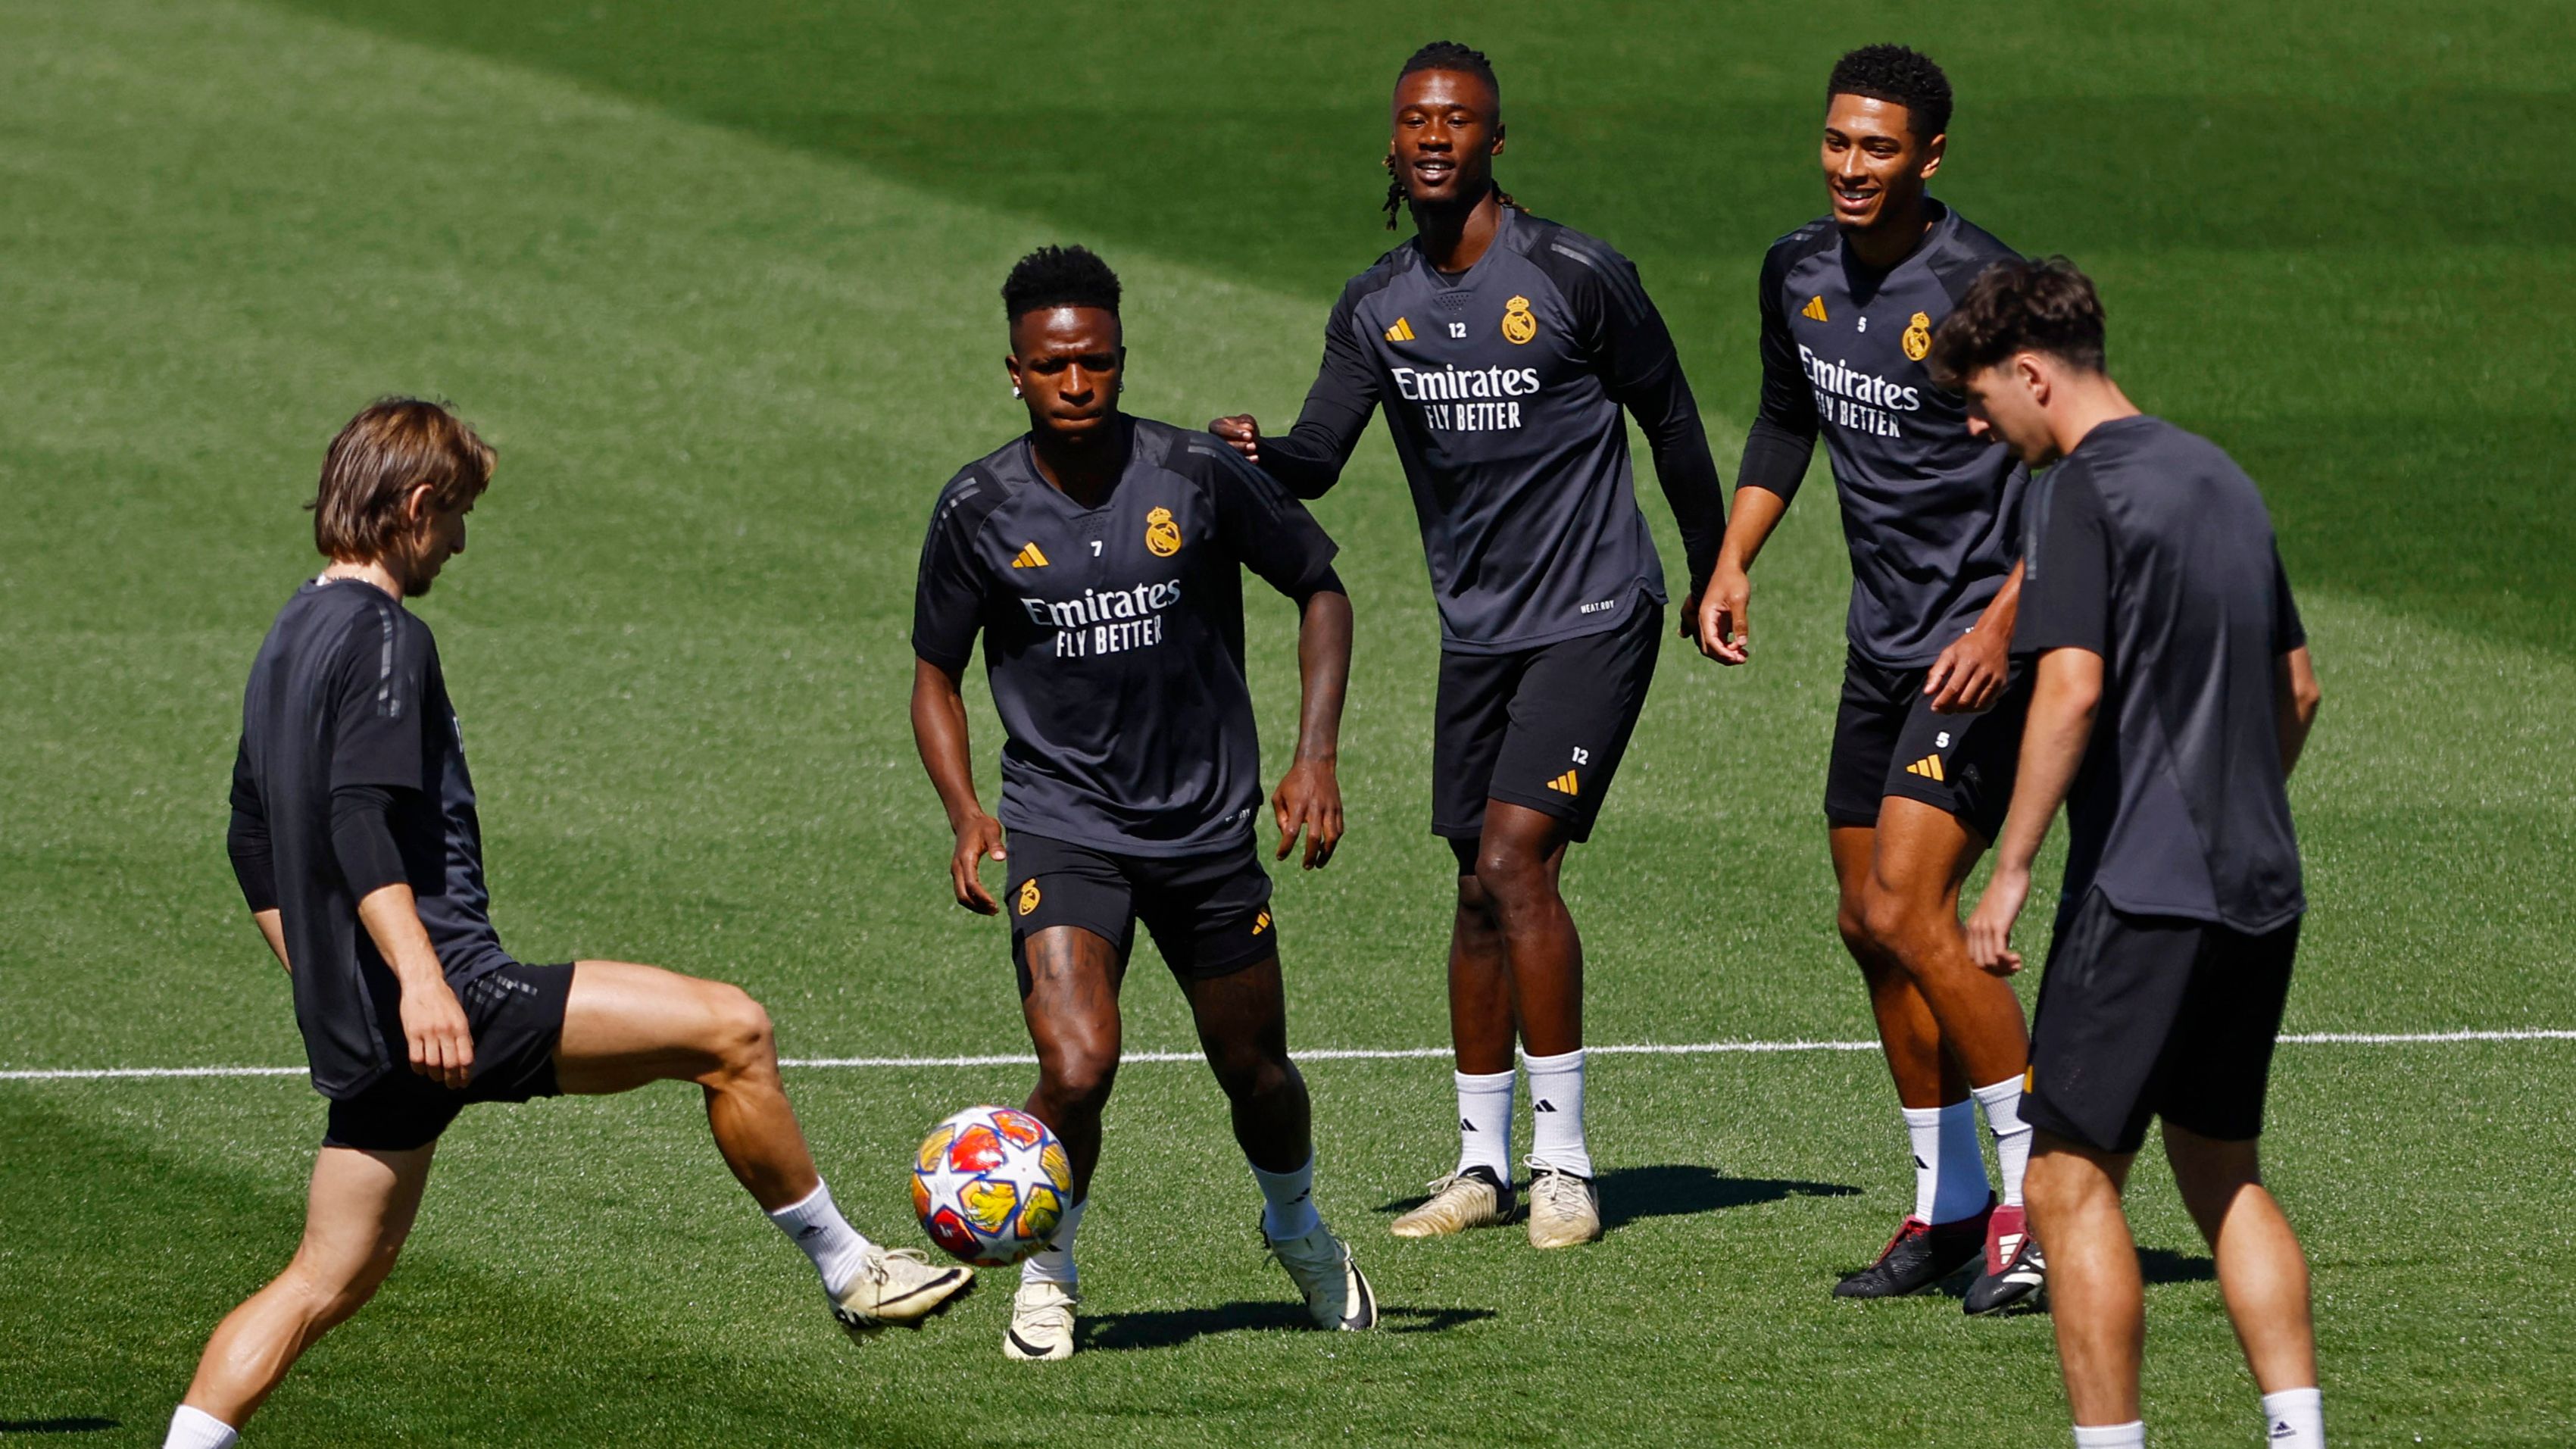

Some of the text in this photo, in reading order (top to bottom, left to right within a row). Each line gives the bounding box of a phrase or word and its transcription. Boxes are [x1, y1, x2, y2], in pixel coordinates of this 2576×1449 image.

[1449, 322, 1466, 339] 12
[1857, 317, 1867, 333] 5
[1391, 364, 1540, 401] Emirates
[1798, 342, 1920, 411] Emirates
[1424, 401, 1522, 431] FLY BETTER
[1814, 390, 1901, 438] FLY BETTER
[1090, 540, 1103, 557] 7
[1020, 579, 1181, 628] Emirates
[1581, 600, 1614, 614] HEAT.RDY
[1056, 614, 1163, 657] FLY BETTER
[1935, 732, 1950, 748] 5
[1572, 746, 1589, 765] 12
